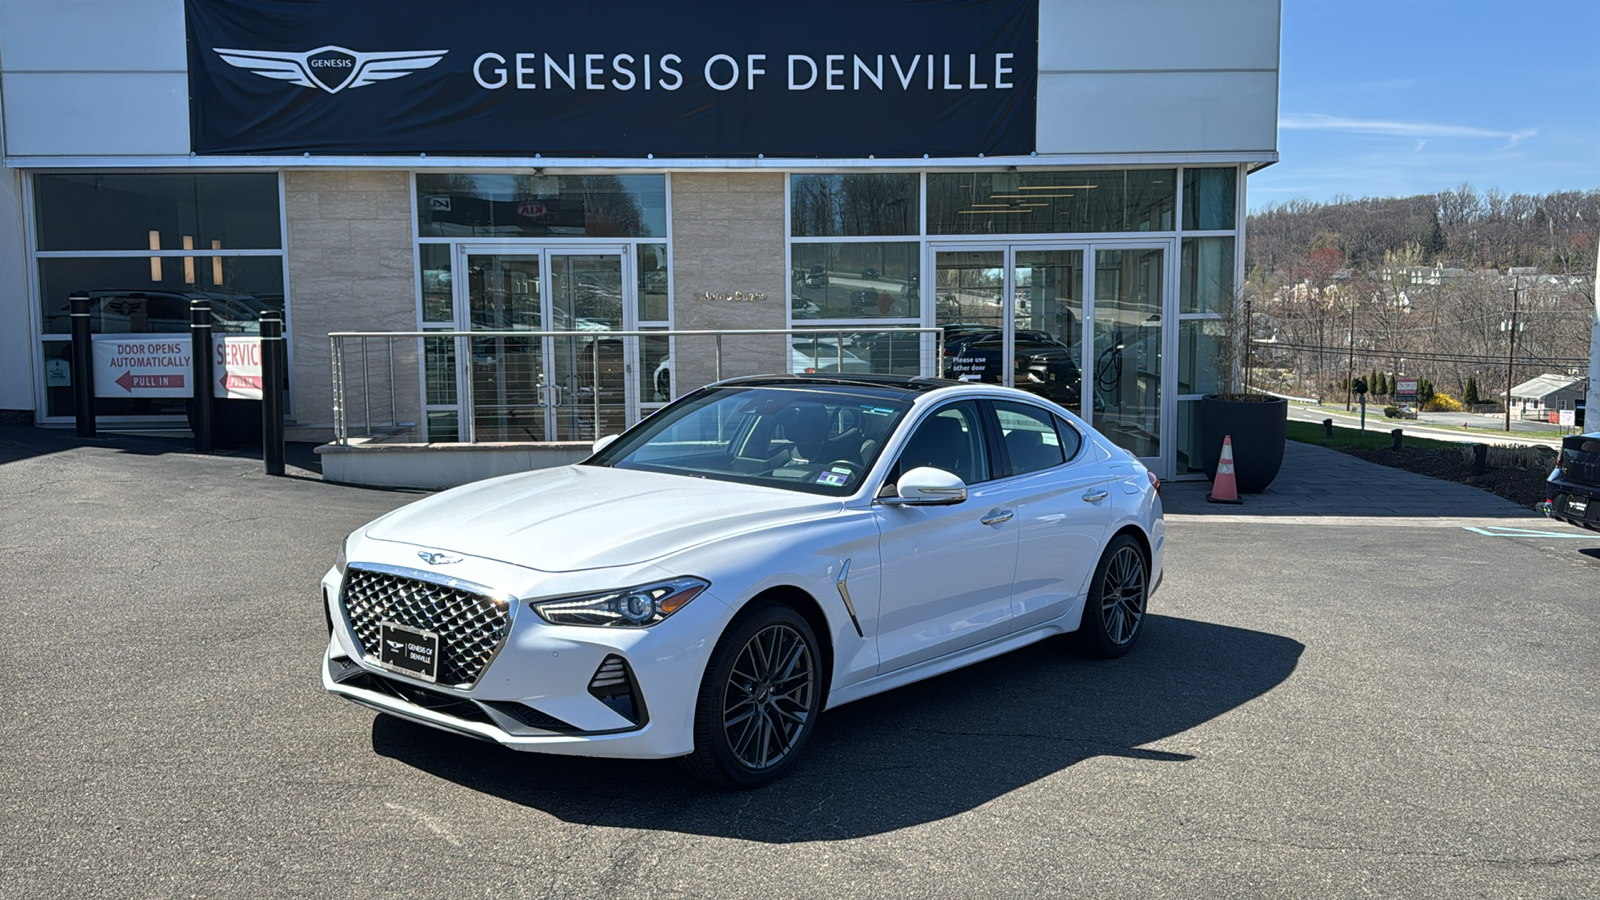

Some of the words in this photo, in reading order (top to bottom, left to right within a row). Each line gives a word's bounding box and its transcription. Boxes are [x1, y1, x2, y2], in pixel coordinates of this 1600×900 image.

[311, 59, 352, 68] GENESIS
[474, 53, 682, 91] GENESIS
[704, 53, 766, 91] OF
[787, 52, 1014, 91] DENVILLE
[117, 344, 146, 355] DOOR
[147, 343, 181, 354] OPENS
[110, 356, 191, 368] AUTOMATICALLY
[133, 377, 156, 386] PULL
[159, 377, 169, 386] IN
[410, 652, 431, 664] DENVILLE
